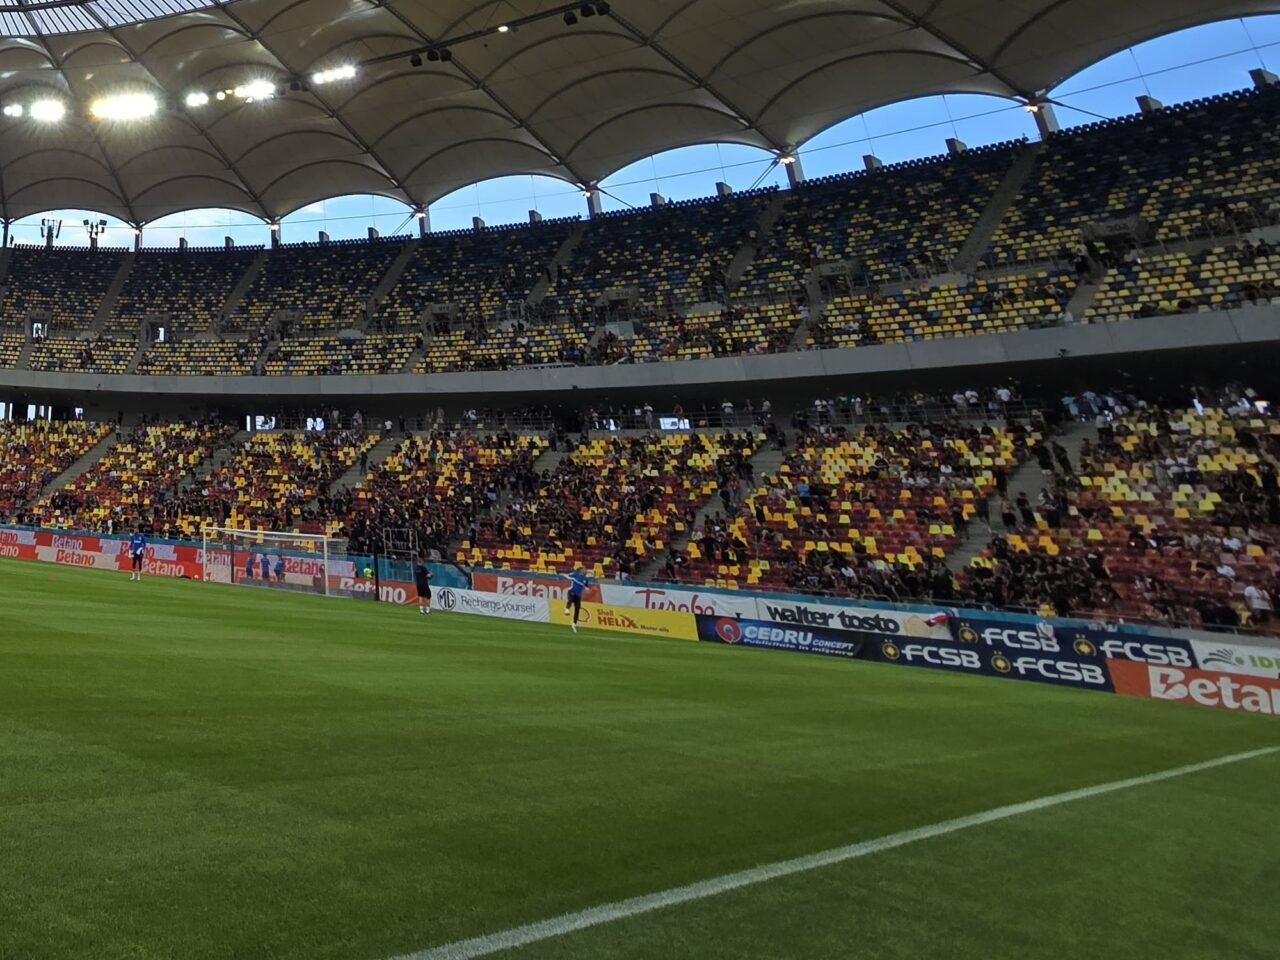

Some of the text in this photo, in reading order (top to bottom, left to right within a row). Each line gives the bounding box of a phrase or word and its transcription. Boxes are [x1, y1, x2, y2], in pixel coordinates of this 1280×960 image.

[51, 535, 83, 550] Betano
[120, 541, 155, 558] Bno
[56, 549, 95, 565] Betano
[141, 558, 184, 577] Betano
[339, 577, 406, 604] Betno
[461, 595, 500, 611] Recharge
[500, 601, 536, 614] yourself
[598, 615, 639, 629] HELIX
[766, 605, 900, 633] walter tosto
[744, 626, 854, 650] CEDRU CONCEPT
[901, 644, 981, 669] FCSB
[1099, 640, 1192, 668] FCSB
[1012, 657, 1106, 685] FCSB
